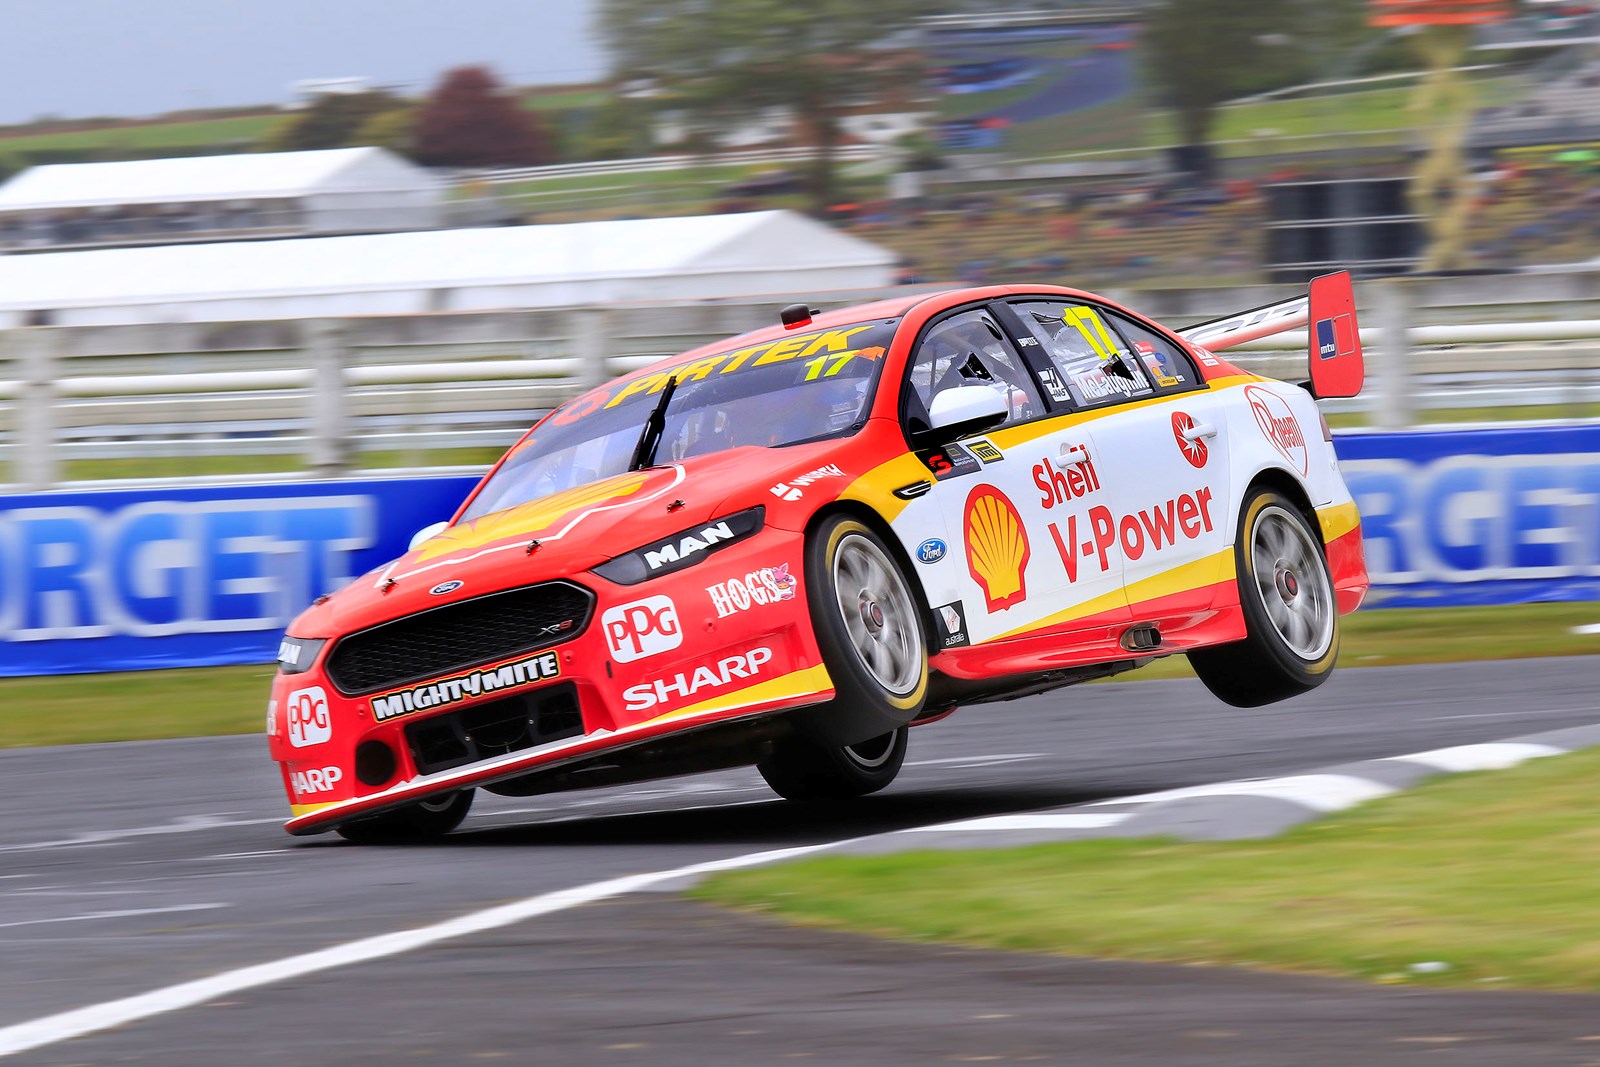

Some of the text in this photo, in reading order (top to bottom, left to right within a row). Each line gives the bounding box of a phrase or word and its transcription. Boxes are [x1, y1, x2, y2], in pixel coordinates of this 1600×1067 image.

[1063, 306, 1121, 360] 17
[1320, 343, 1335, 355] mtu
[604, 326, 875, 409] PIRTEK
[804, 350, 861, 381] 17
[1250, 391, 1304, 461] Rheem
[1032, 444, 1100, 509] Shell
[644, 521, 734, 570] MAN
[922, 541, 943, 561] Ford
[1048, 486, 1214, 584] V-Power
[0, 494, 378, 641] RGET
[537, 619, 573, 637] XR8
[607, 605, 678, 655] PPG
[622, 647, 773, 711] SHARP
[290, 693, 327, 741] PPG
